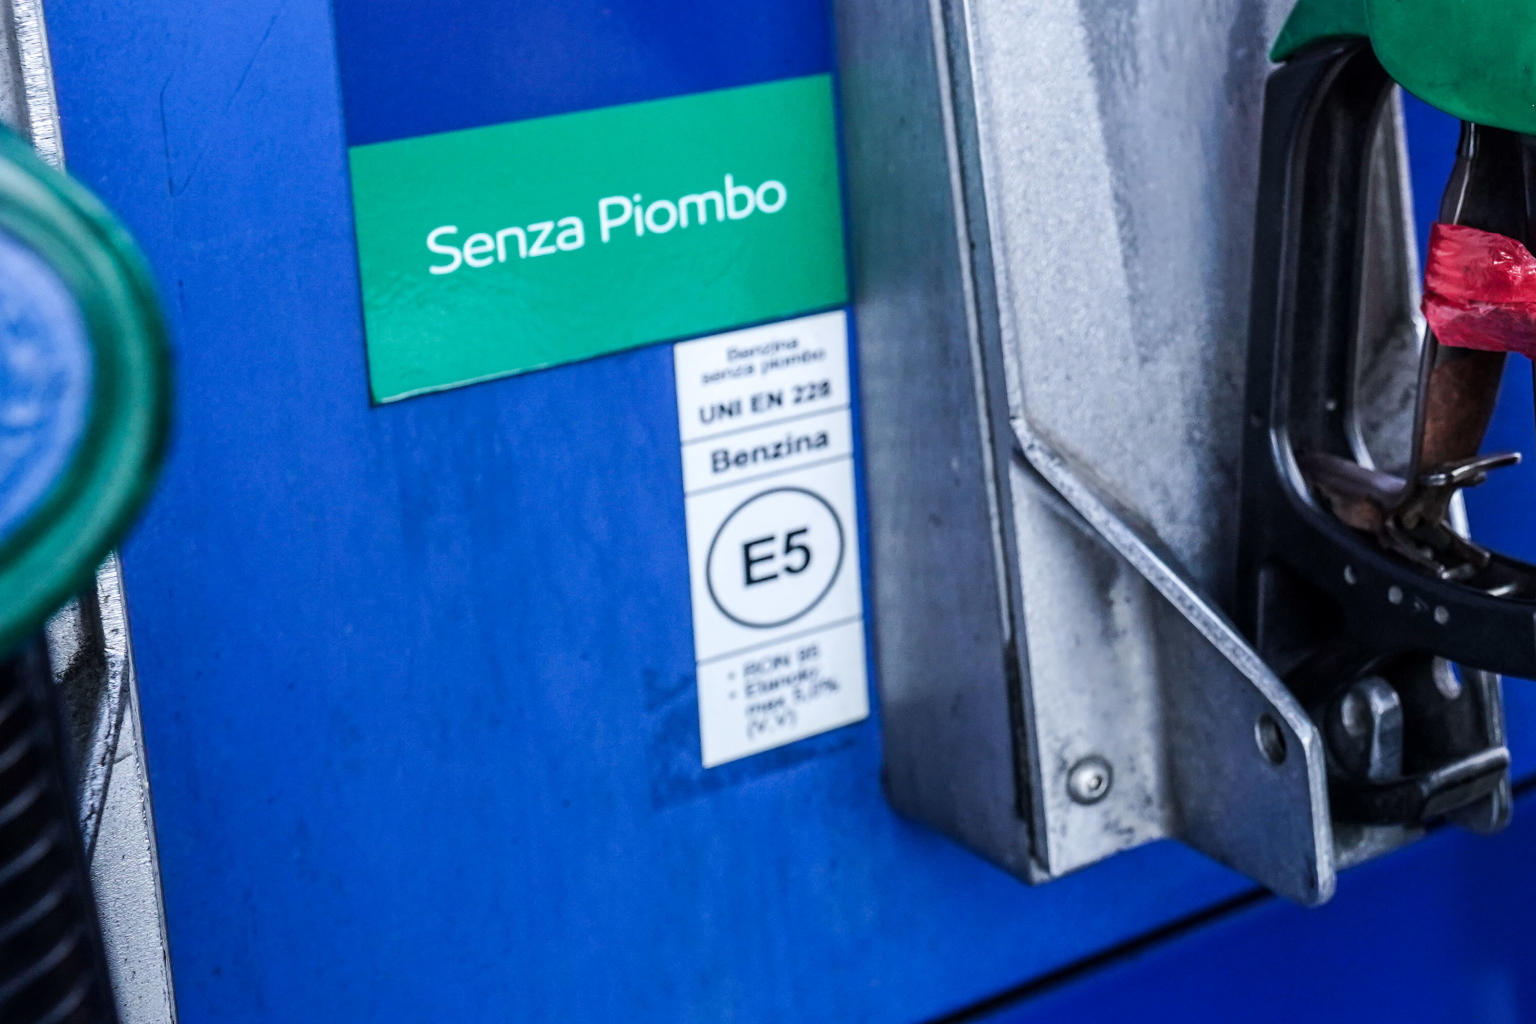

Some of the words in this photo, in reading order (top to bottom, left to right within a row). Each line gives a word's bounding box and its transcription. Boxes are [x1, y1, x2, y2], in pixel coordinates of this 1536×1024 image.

[426, 215, 586, 276] Senza
[598, 173, 788, 244] Piombo
[699, 399, 742, 424] UNI
[750, 391, 783, 414] EN
[792, 379, 831, 404] 228
[711, 430, 829, 474] Benzina
[741, 527, 813, 589] E5
